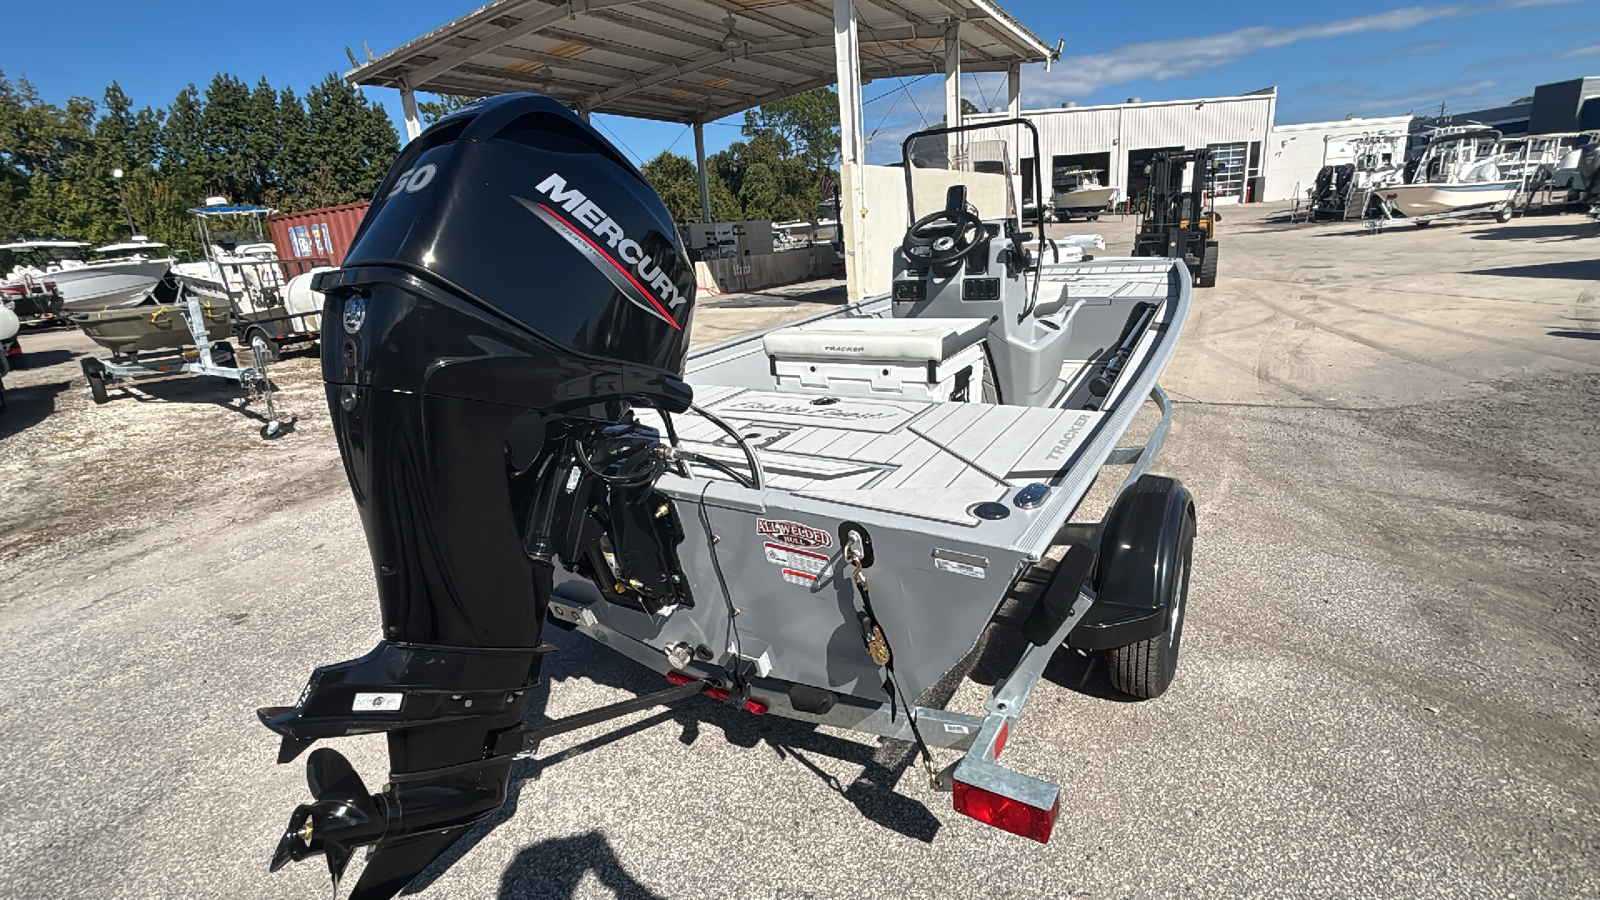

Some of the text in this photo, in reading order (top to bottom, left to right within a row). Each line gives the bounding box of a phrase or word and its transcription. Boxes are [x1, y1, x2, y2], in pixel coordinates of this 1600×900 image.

[534, 172, 688, 310] MERCURY
[1045, 414, 1091, 461] TRACKER
[758, 519, 830, 546] ALL WELDED
[784, 536, 806, 546] HULL
